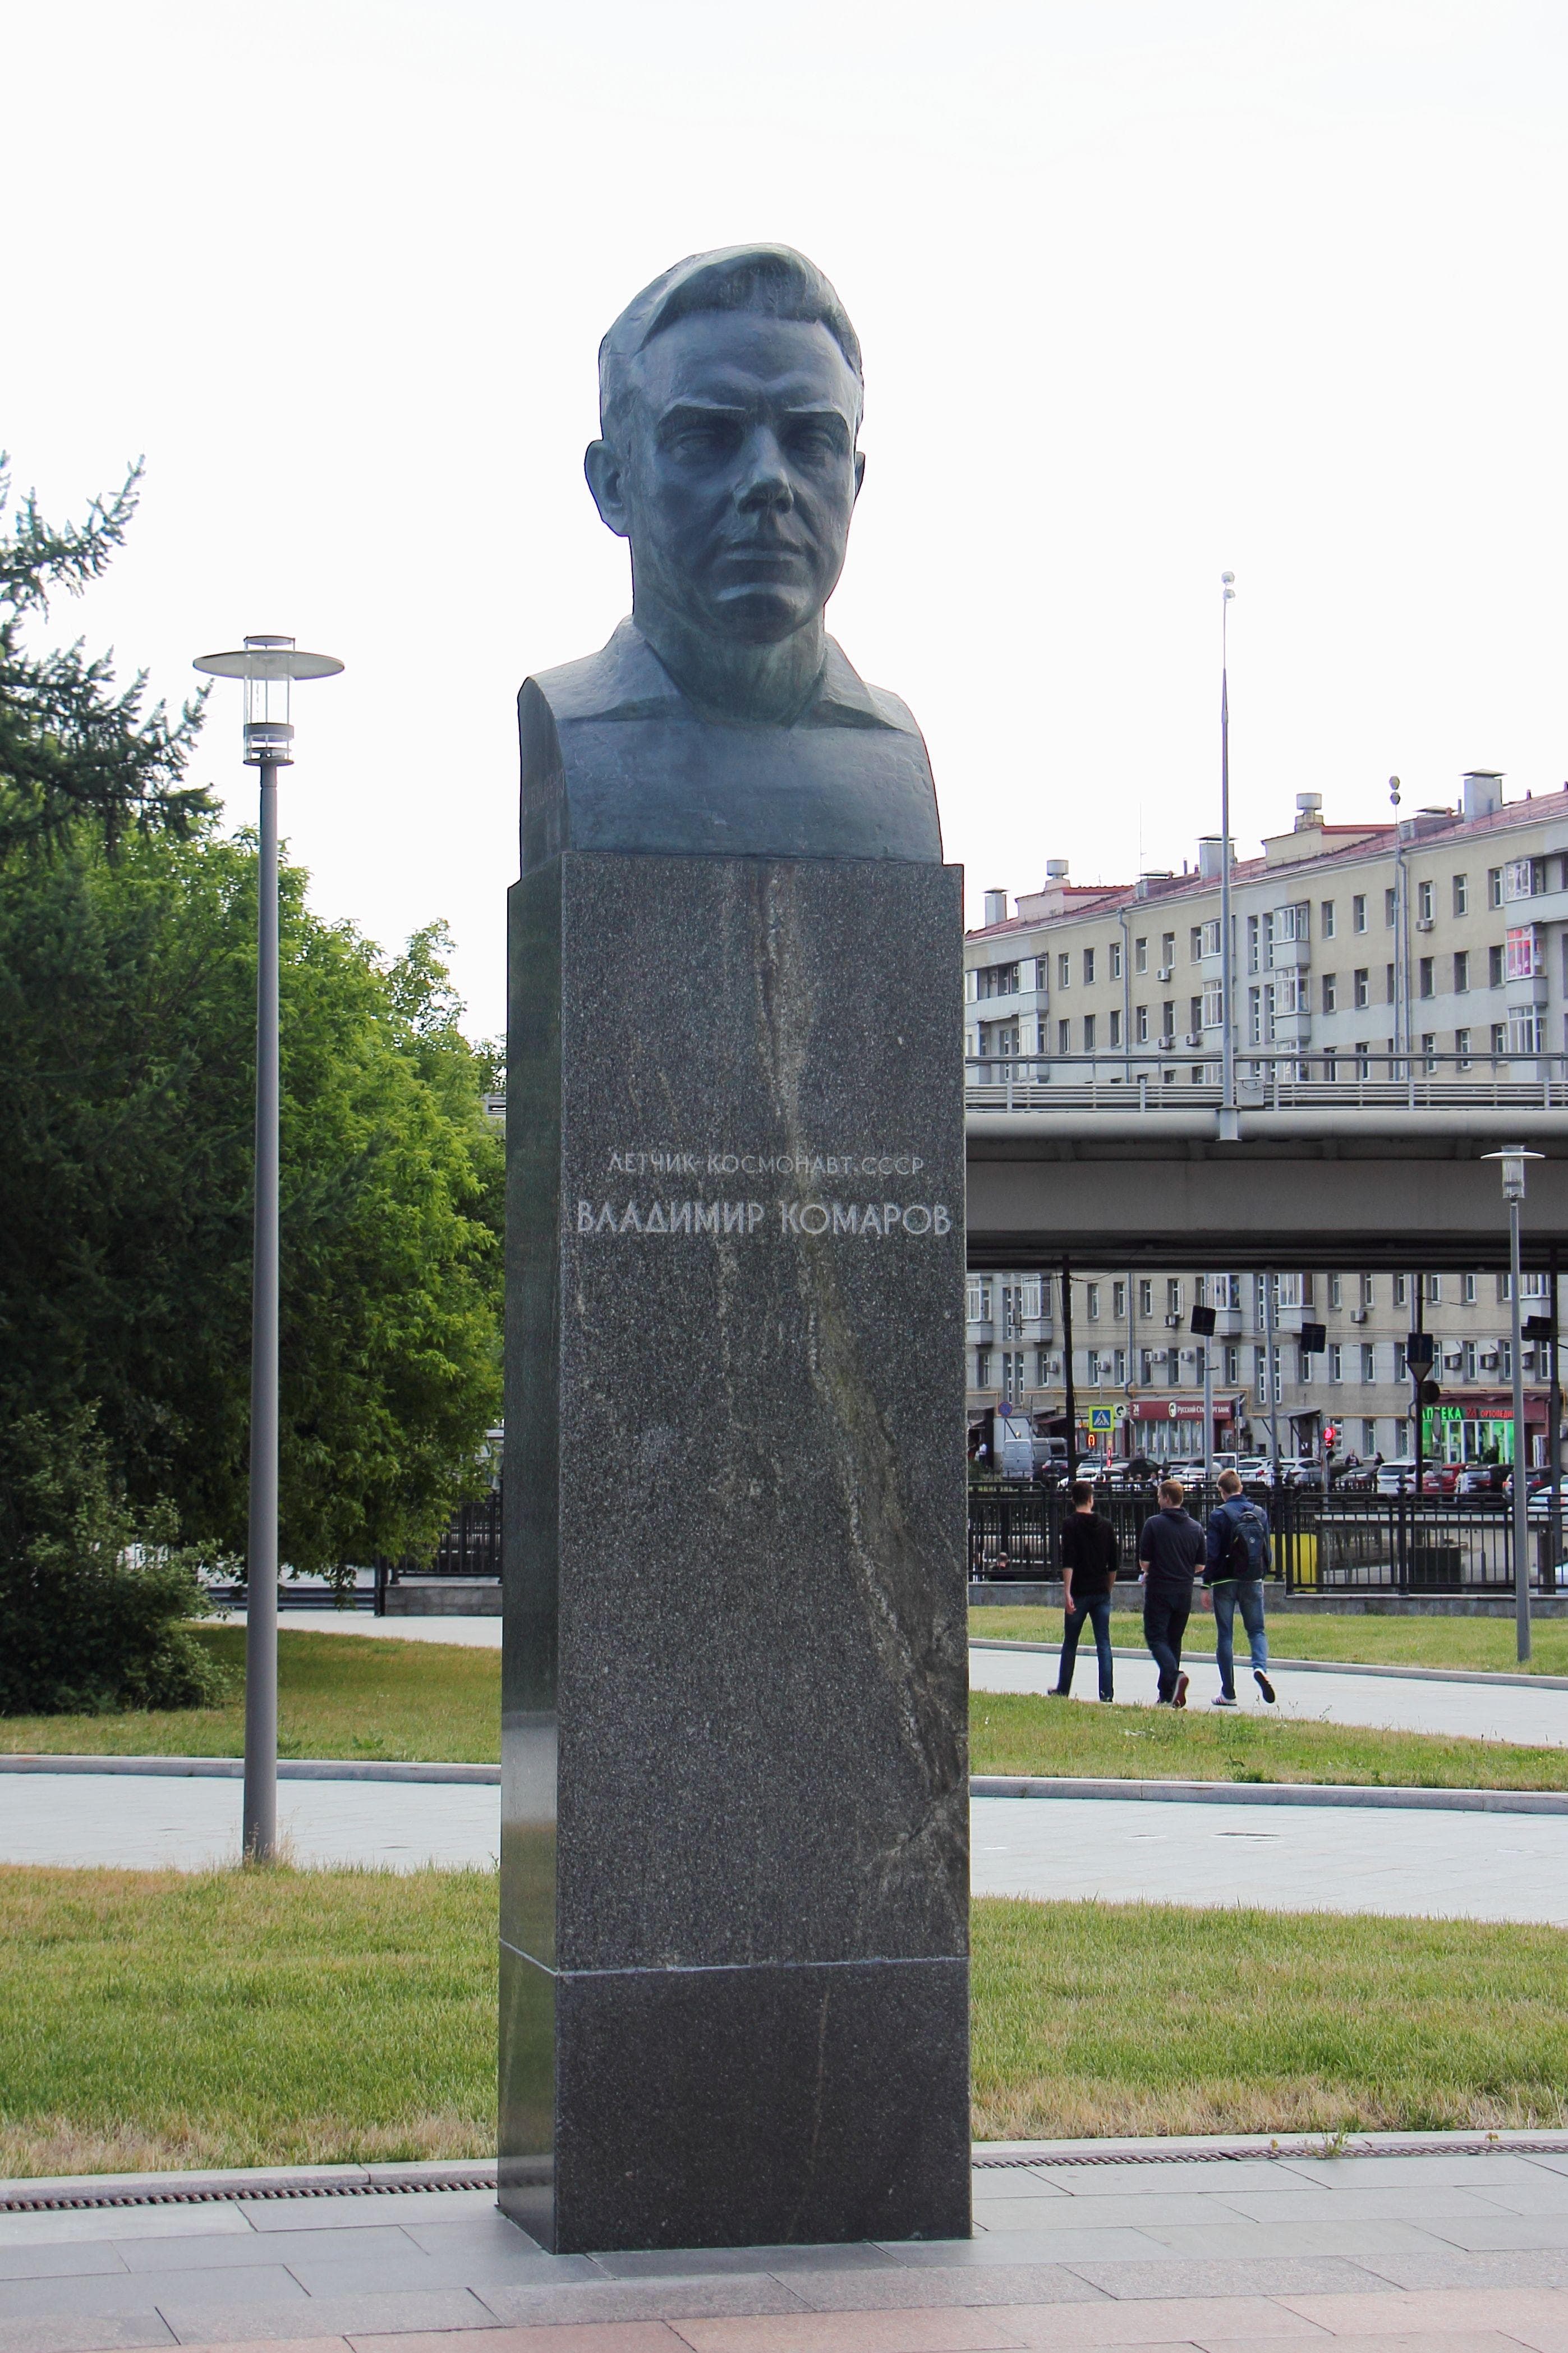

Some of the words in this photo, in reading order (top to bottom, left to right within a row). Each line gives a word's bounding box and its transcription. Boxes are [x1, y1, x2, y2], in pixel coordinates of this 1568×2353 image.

[862, 1156, 924, 1175] СССР
[578, 1200, 765, 1233] ВЛАДИМИР
[782, 1203, 951, 1235] КОМАРОВ
